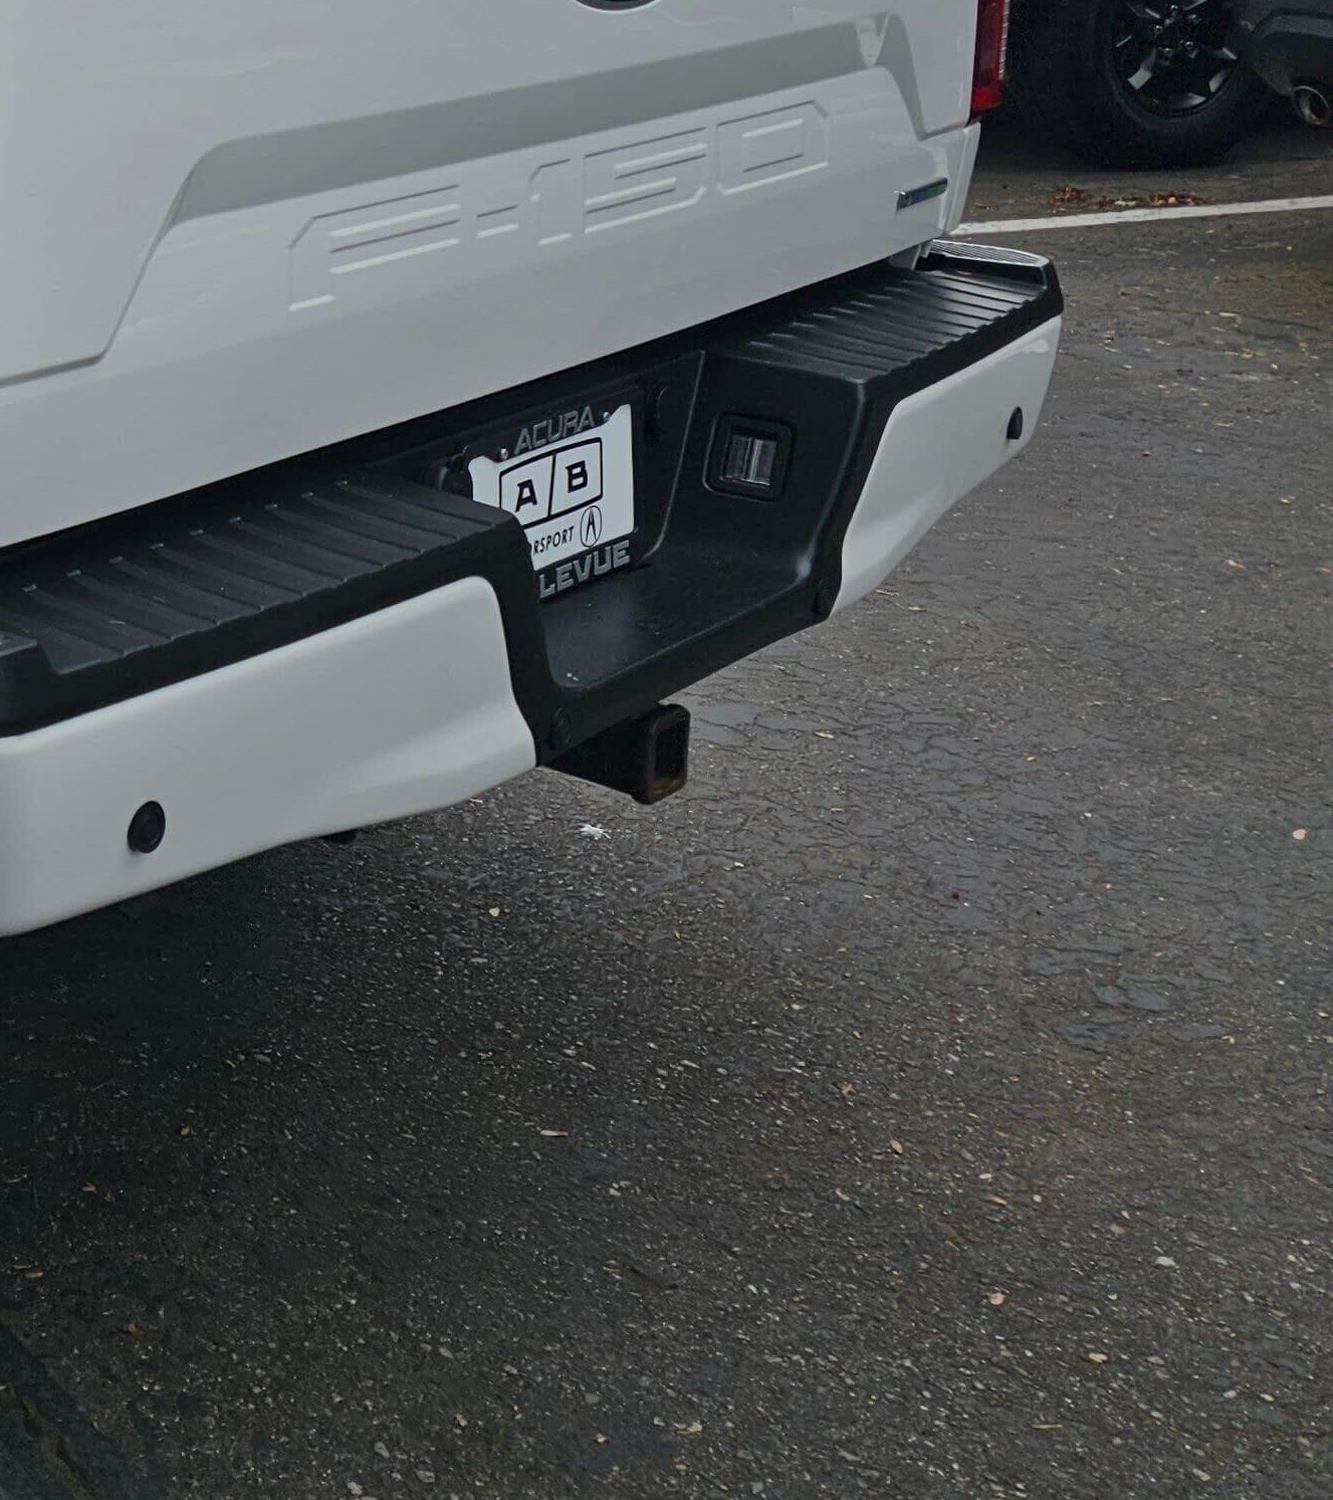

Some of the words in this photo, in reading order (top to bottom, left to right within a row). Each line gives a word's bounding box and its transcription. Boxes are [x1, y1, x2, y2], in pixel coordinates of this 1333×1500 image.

[288, 100, 829, 312] F-150
[514, 405, 595, 456] ACURA
[514, 478, 538, 513] A
[564, 459, 589, 494] B
